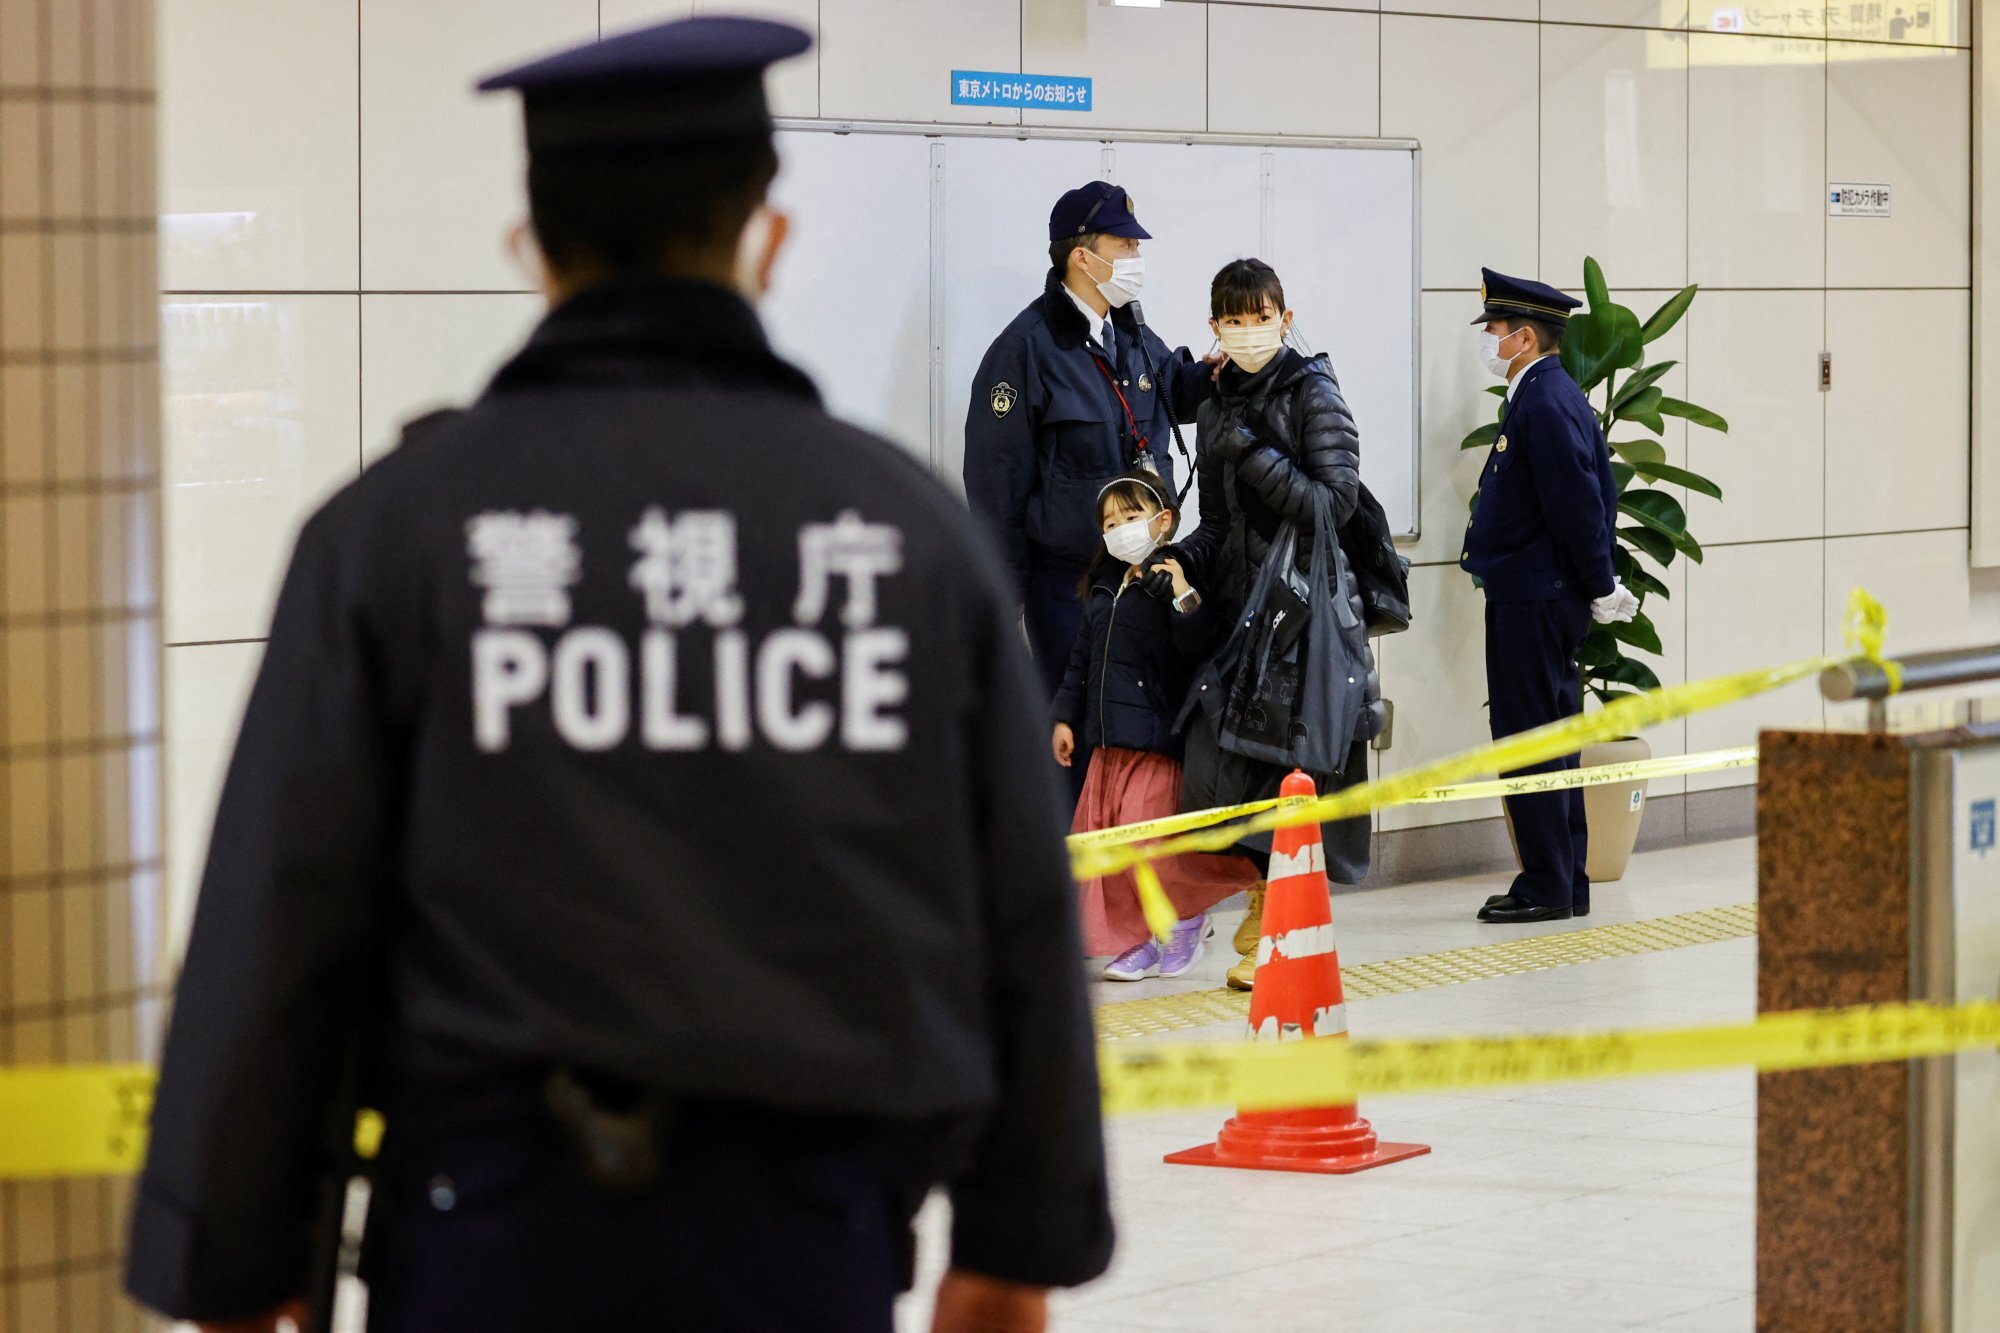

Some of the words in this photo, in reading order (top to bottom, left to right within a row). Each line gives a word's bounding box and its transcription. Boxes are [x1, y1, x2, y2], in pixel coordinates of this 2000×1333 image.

[958, 79, 1087, 103] 東京メトロからのお知らせ
[466, 507, 903, 628] 警視庁
[472, 626, 907, 752] POLICE
